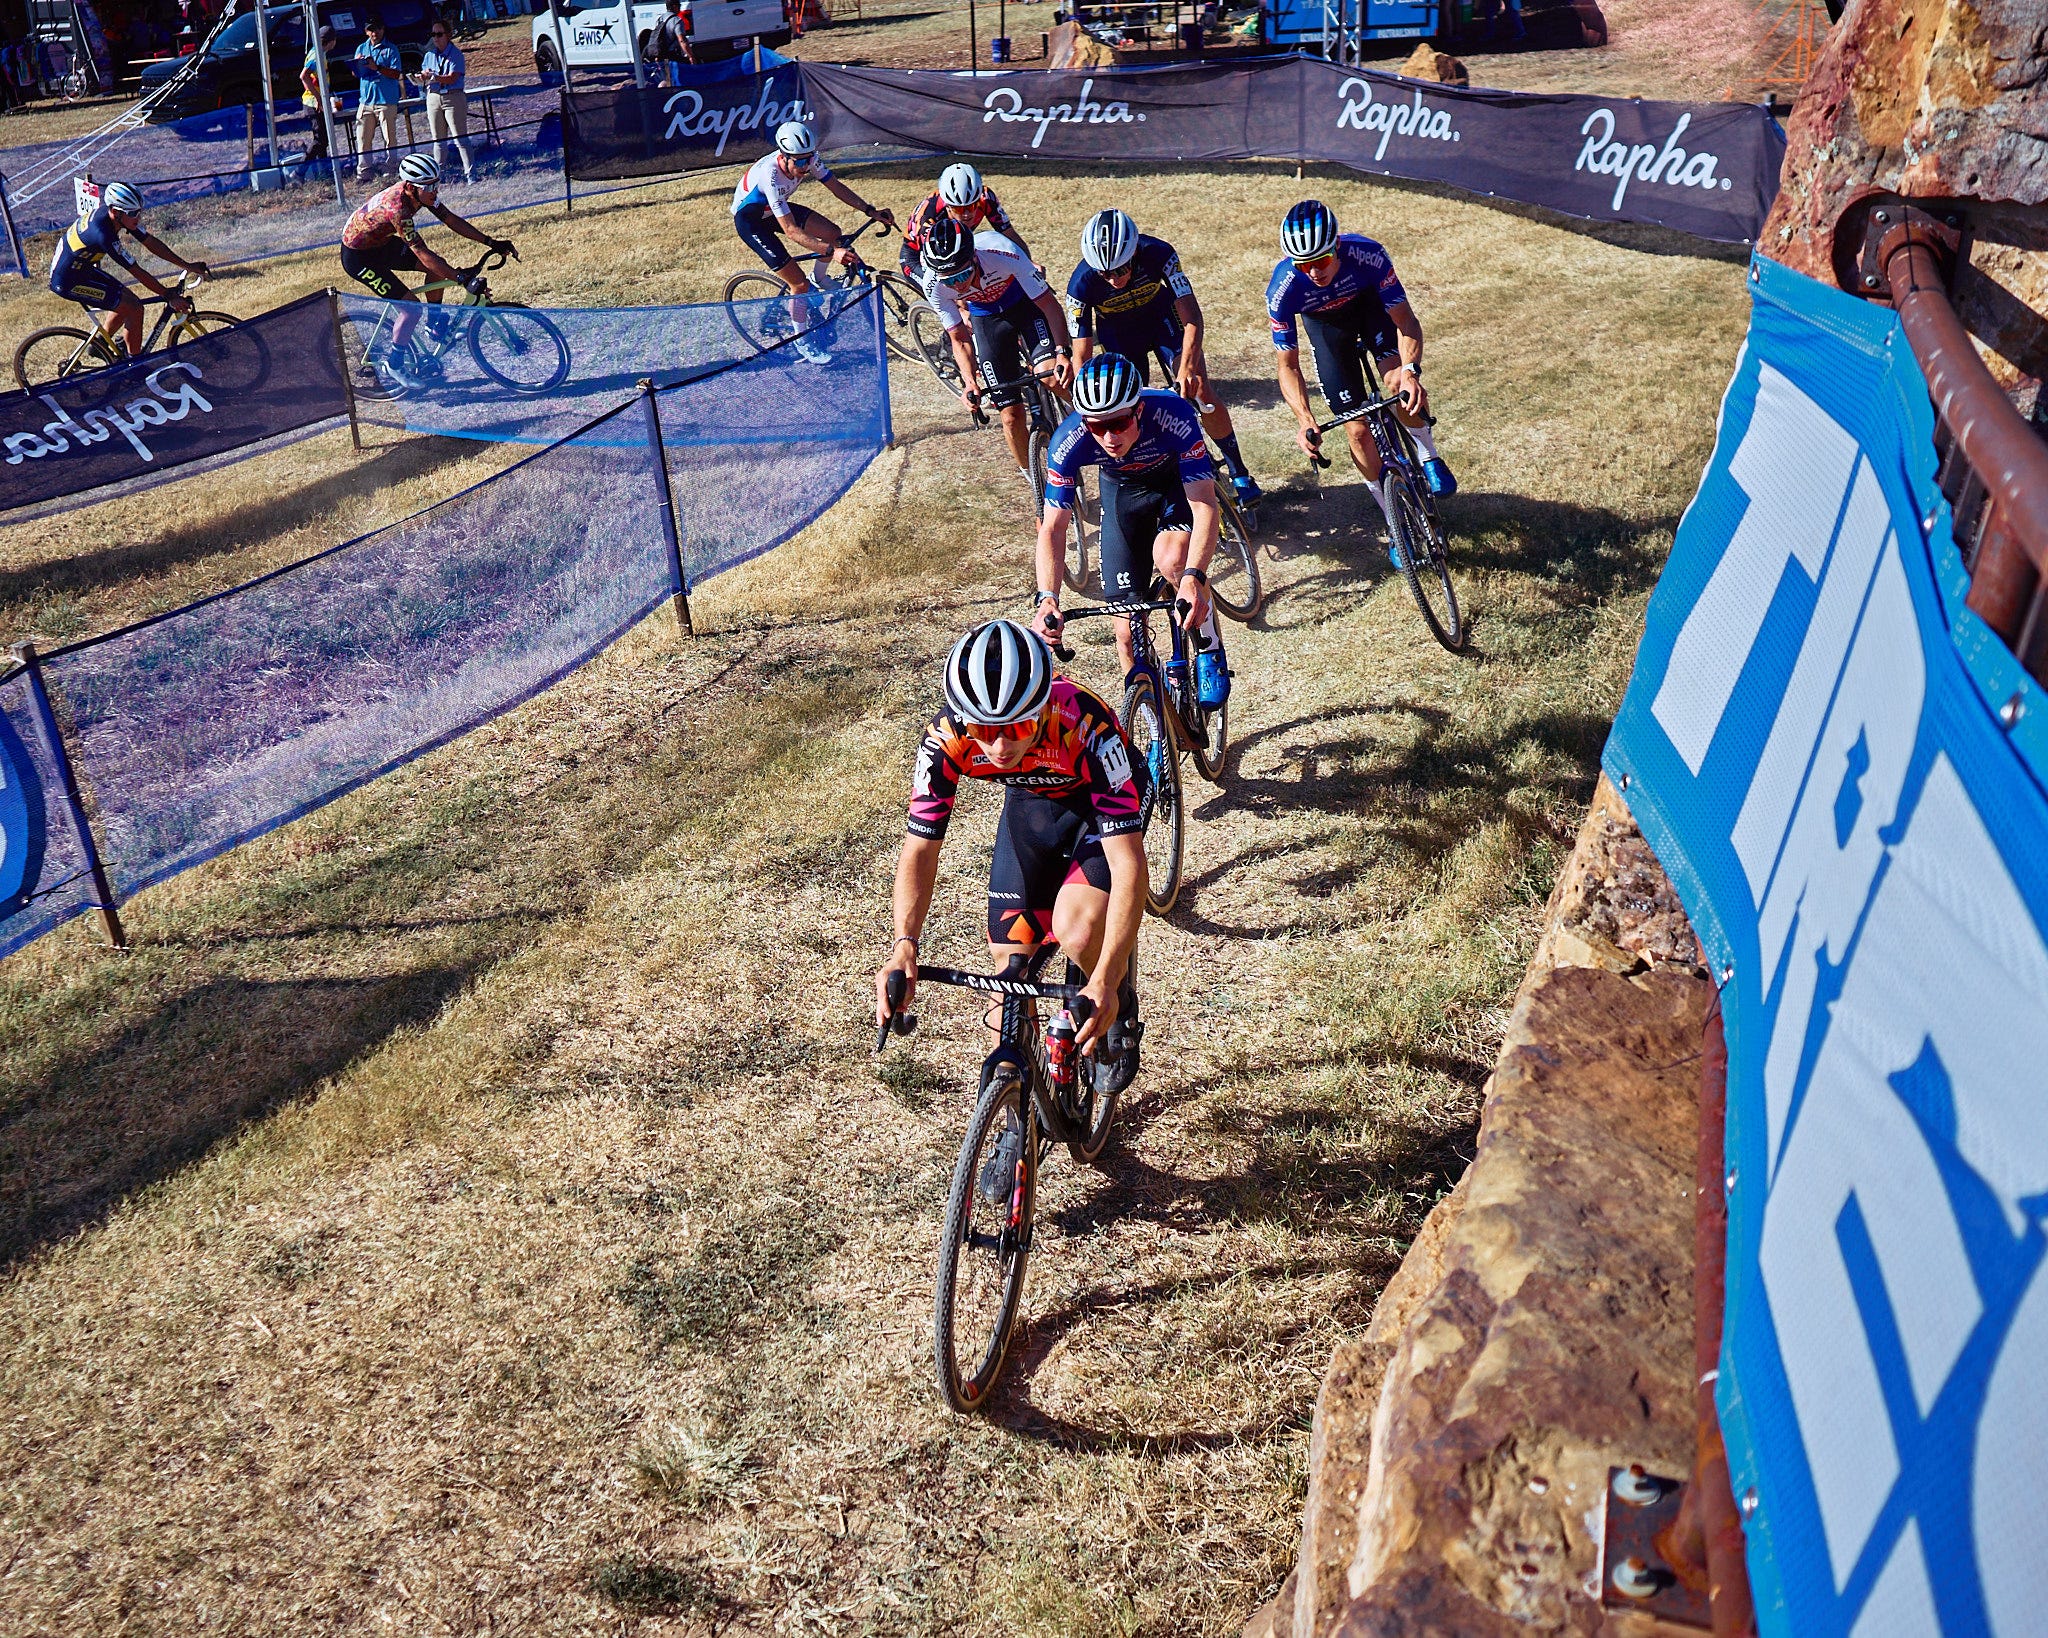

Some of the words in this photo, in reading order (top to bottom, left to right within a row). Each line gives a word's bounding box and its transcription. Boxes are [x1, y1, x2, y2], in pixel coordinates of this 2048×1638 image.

[573, 27, 603, 46] Lewis
[1348, 245, 1384, 269] Alpecin
[1172, 275, 1188, 290] 113
[1270, 270, 1296, 311] deceuninck
[984, 363, 998, 387] KASP
[1153, 407, 1193, 440] Alpecin
[1052, 421, 1088, 465] deceuninck
[1100, 602, 1151, 614] CANYON
[1105, 742, 1127, 771] 117
[1115, 819, 1141, 829] LEGEND
[967, 975, 1039, 996] CANYON
